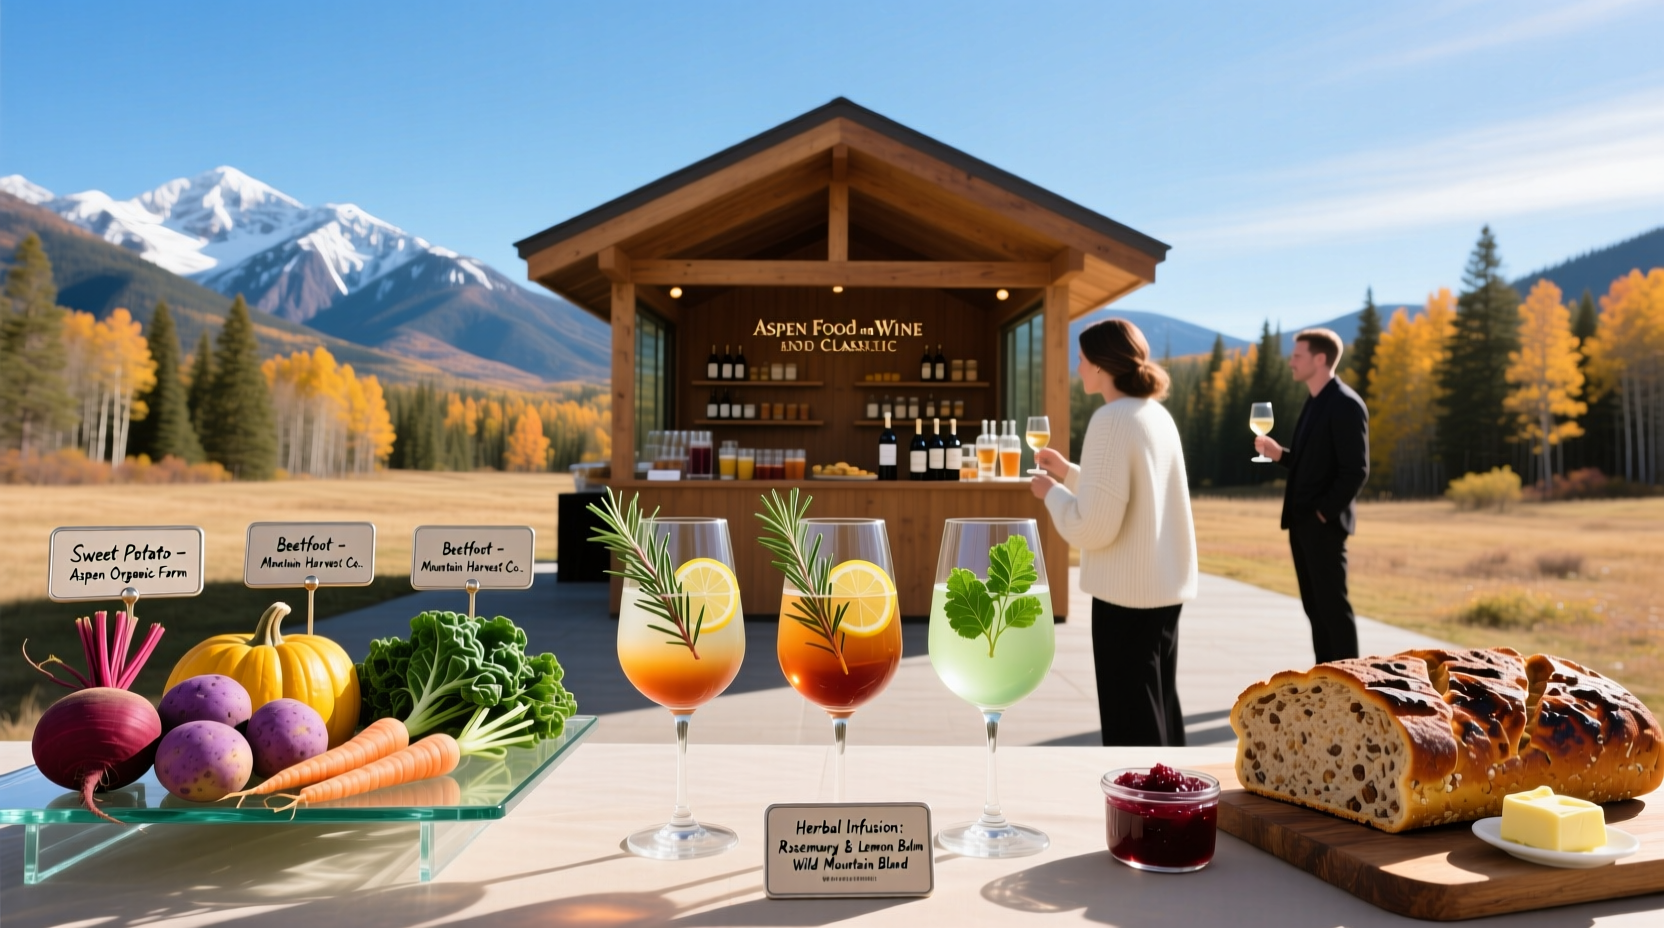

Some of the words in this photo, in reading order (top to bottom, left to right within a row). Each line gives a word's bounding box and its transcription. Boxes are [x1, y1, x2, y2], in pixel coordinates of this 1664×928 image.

[874, 319, 923, 337] WINE
[70, 544, 119, 562] Sweet
[123, 543, 171, 562] Potato
[69, 567, 105, 585] Aspen
[793, 857, 818, 871] Wild
